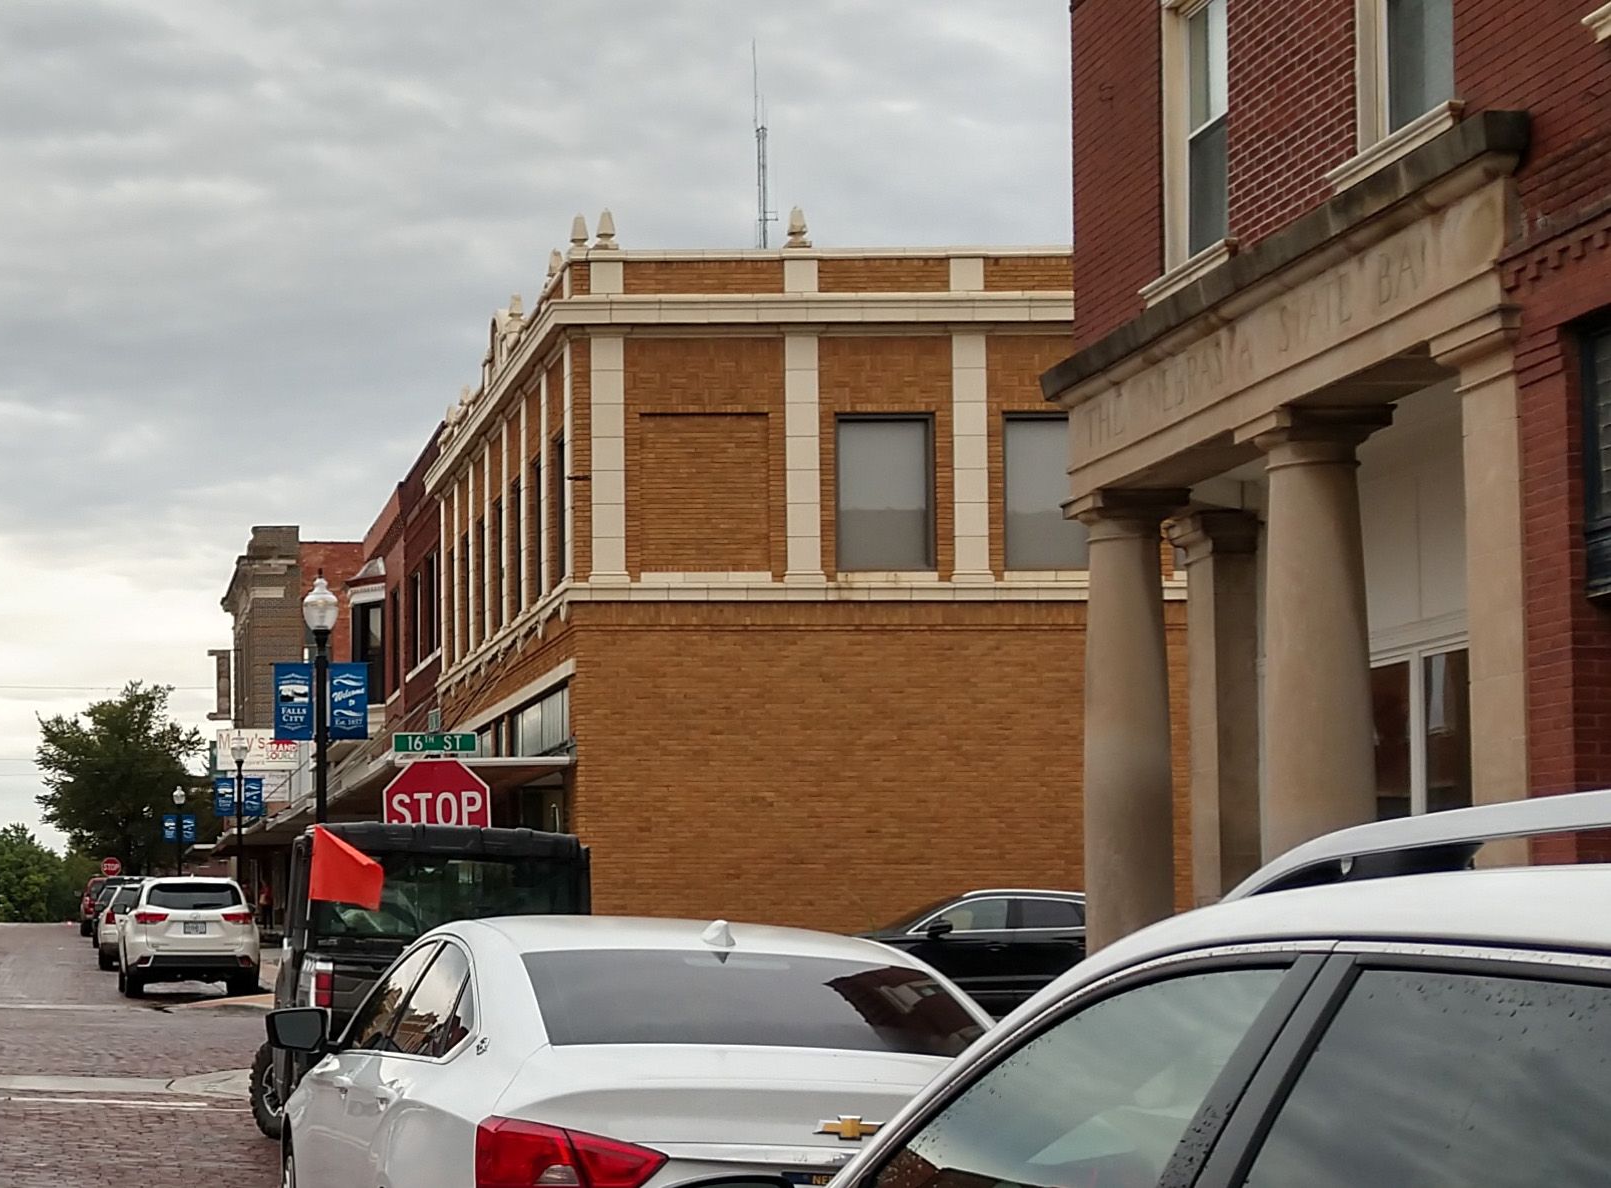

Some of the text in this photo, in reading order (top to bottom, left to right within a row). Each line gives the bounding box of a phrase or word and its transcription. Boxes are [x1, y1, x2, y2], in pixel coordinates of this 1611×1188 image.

[281, 706, 307, 715] FALLS
[282, 714, 305, 722] CITY
[408, 735, 462, 751] 16TH ST
[391, 791, 483, 828] STOP
